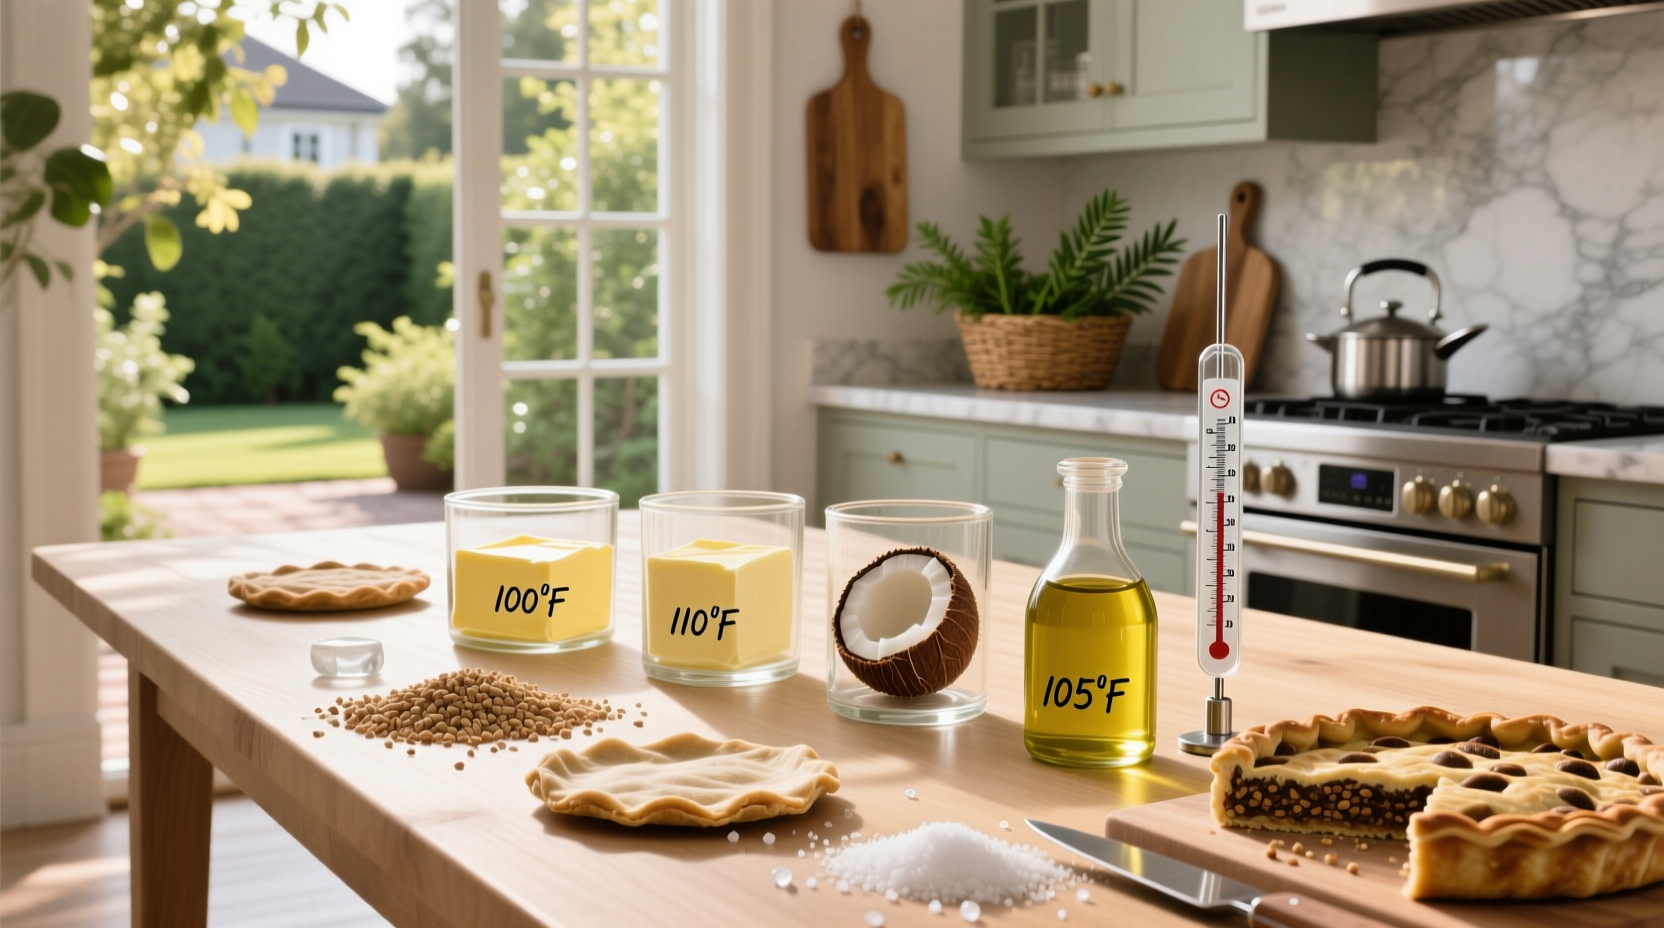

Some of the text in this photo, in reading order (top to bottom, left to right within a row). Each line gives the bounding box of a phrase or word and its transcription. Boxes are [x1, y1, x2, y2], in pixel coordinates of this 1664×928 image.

[494, 583, 570, 618] 100°F
[670, 605, 740, 641] 110°F
[1042, 674, 1130, 714] 105°F
